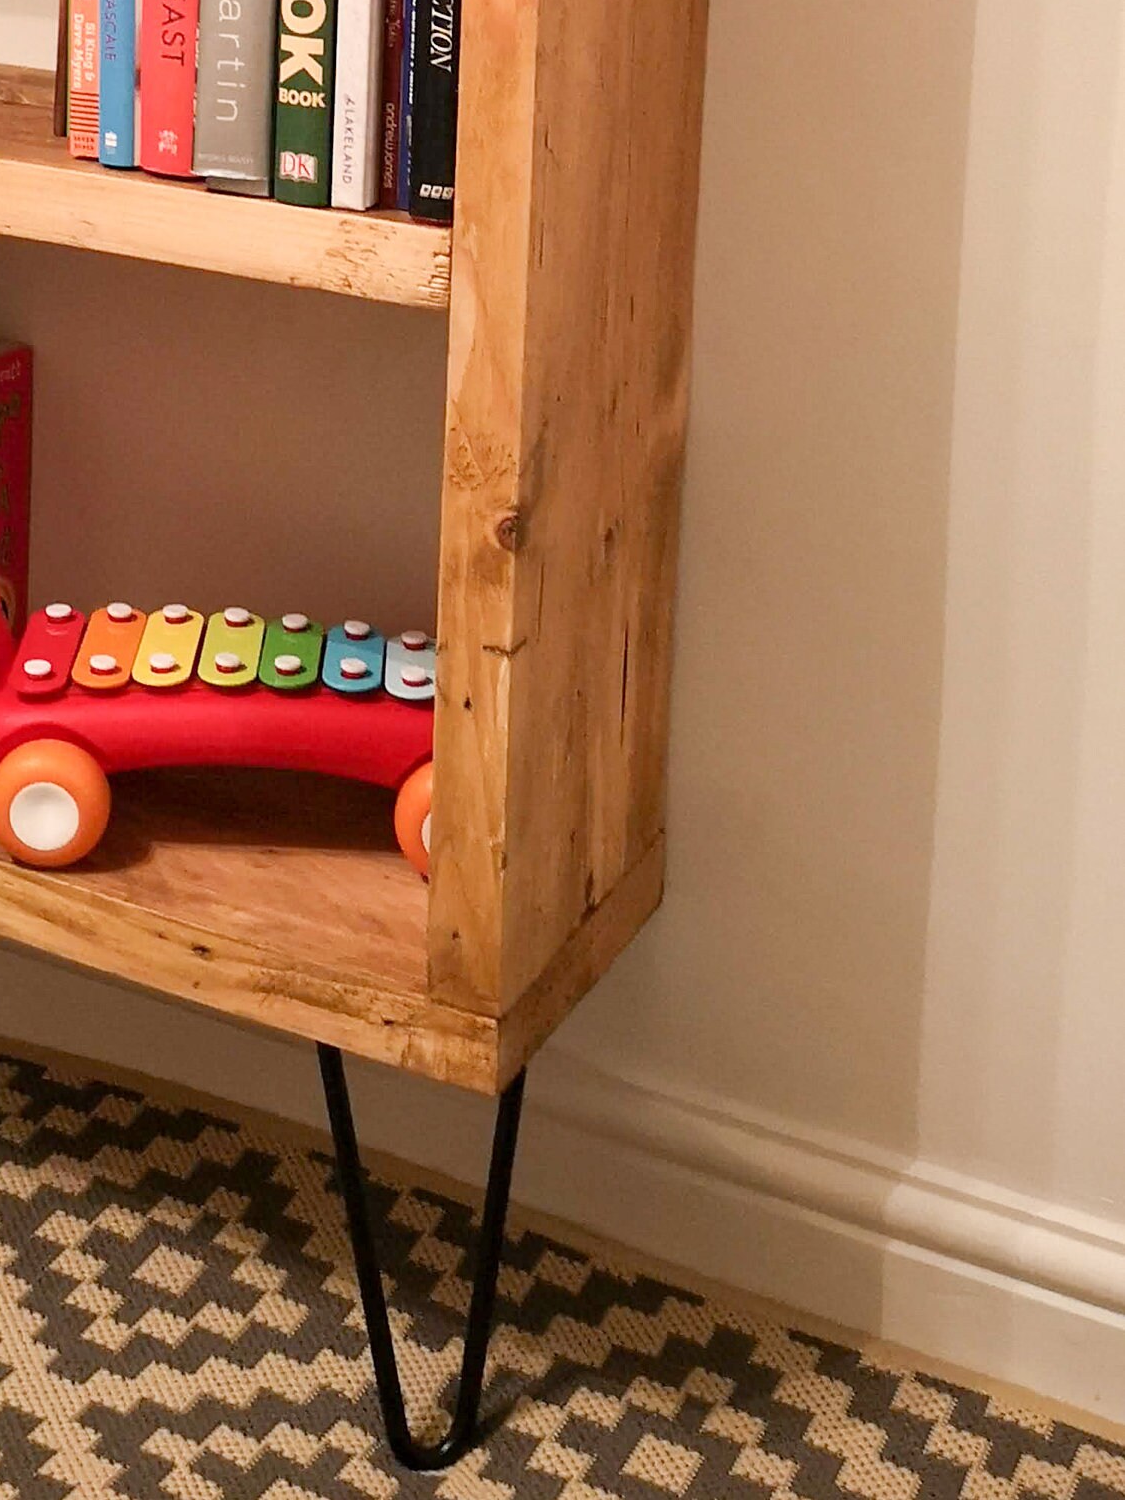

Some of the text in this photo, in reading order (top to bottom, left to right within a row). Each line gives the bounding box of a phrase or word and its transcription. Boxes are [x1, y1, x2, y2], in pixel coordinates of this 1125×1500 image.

[71, 13, 84, 88] Dave Myers
[83, 38, 95, 69] King
[85, 72, 95, 81] &
[278, 87, 327, 109] BOOK
[342, 110, 354, 184] LAKELAND
[281, 153, 312, 179] DK
